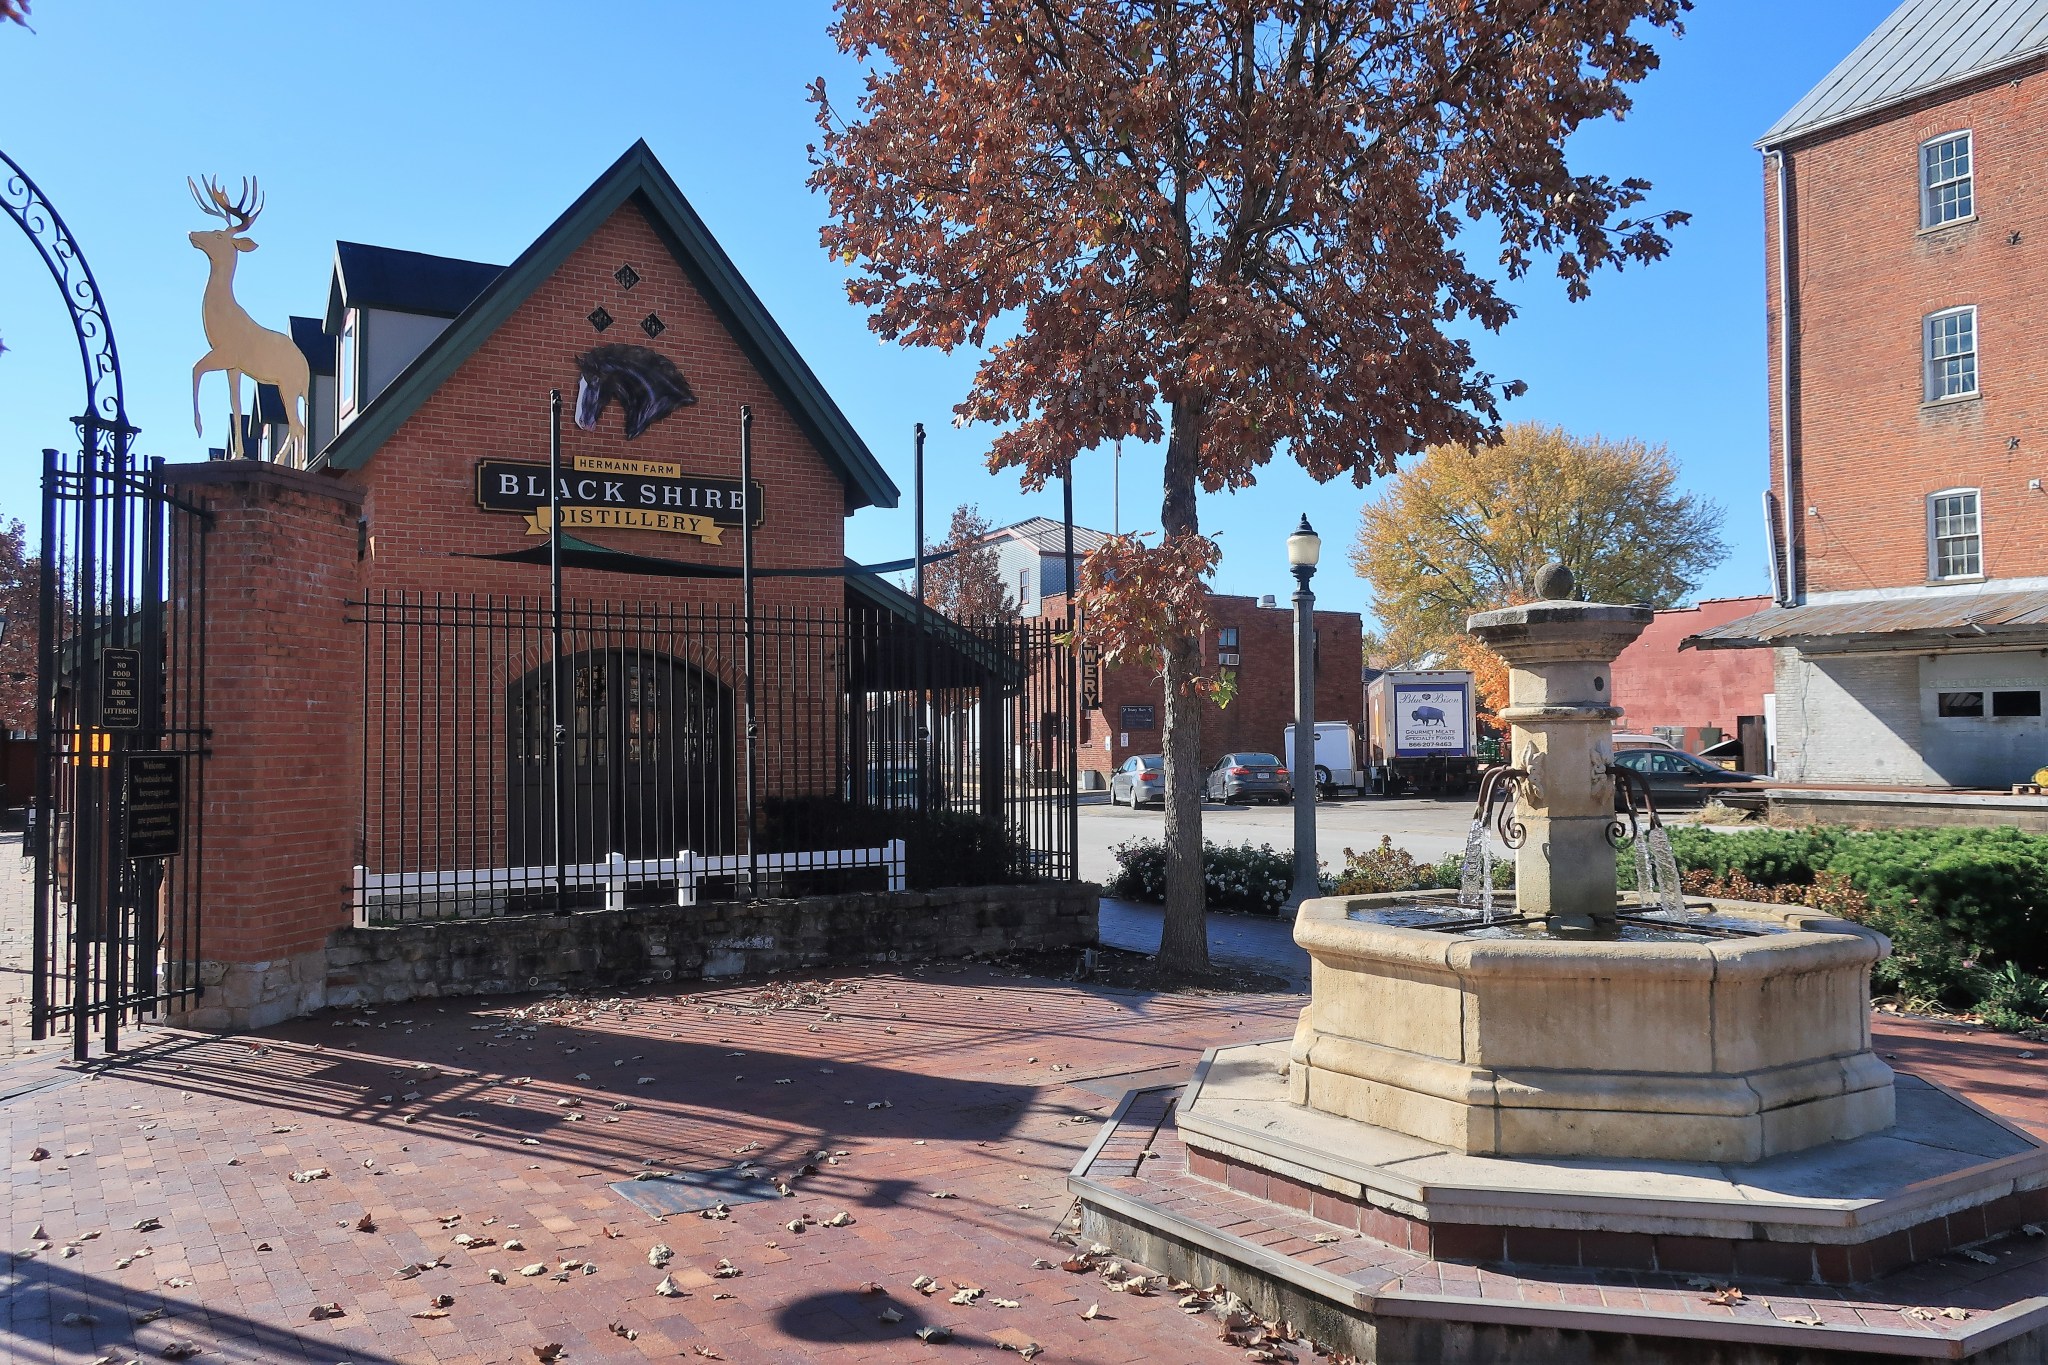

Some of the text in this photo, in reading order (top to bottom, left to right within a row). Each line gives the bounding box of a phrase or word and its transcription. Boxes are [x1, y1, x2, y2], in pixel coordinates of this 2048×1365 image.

[579, 458, 675, 475] HERMANN FARM
[499, 473, 744, 511] BLACK SHIRE
[112, 670, 131, 678] FOOD
[116, 680, 127, 688] NO
[1399, 692, 1459, 704] Blue Bison
[104, 708, 138, 716] LITTERING
